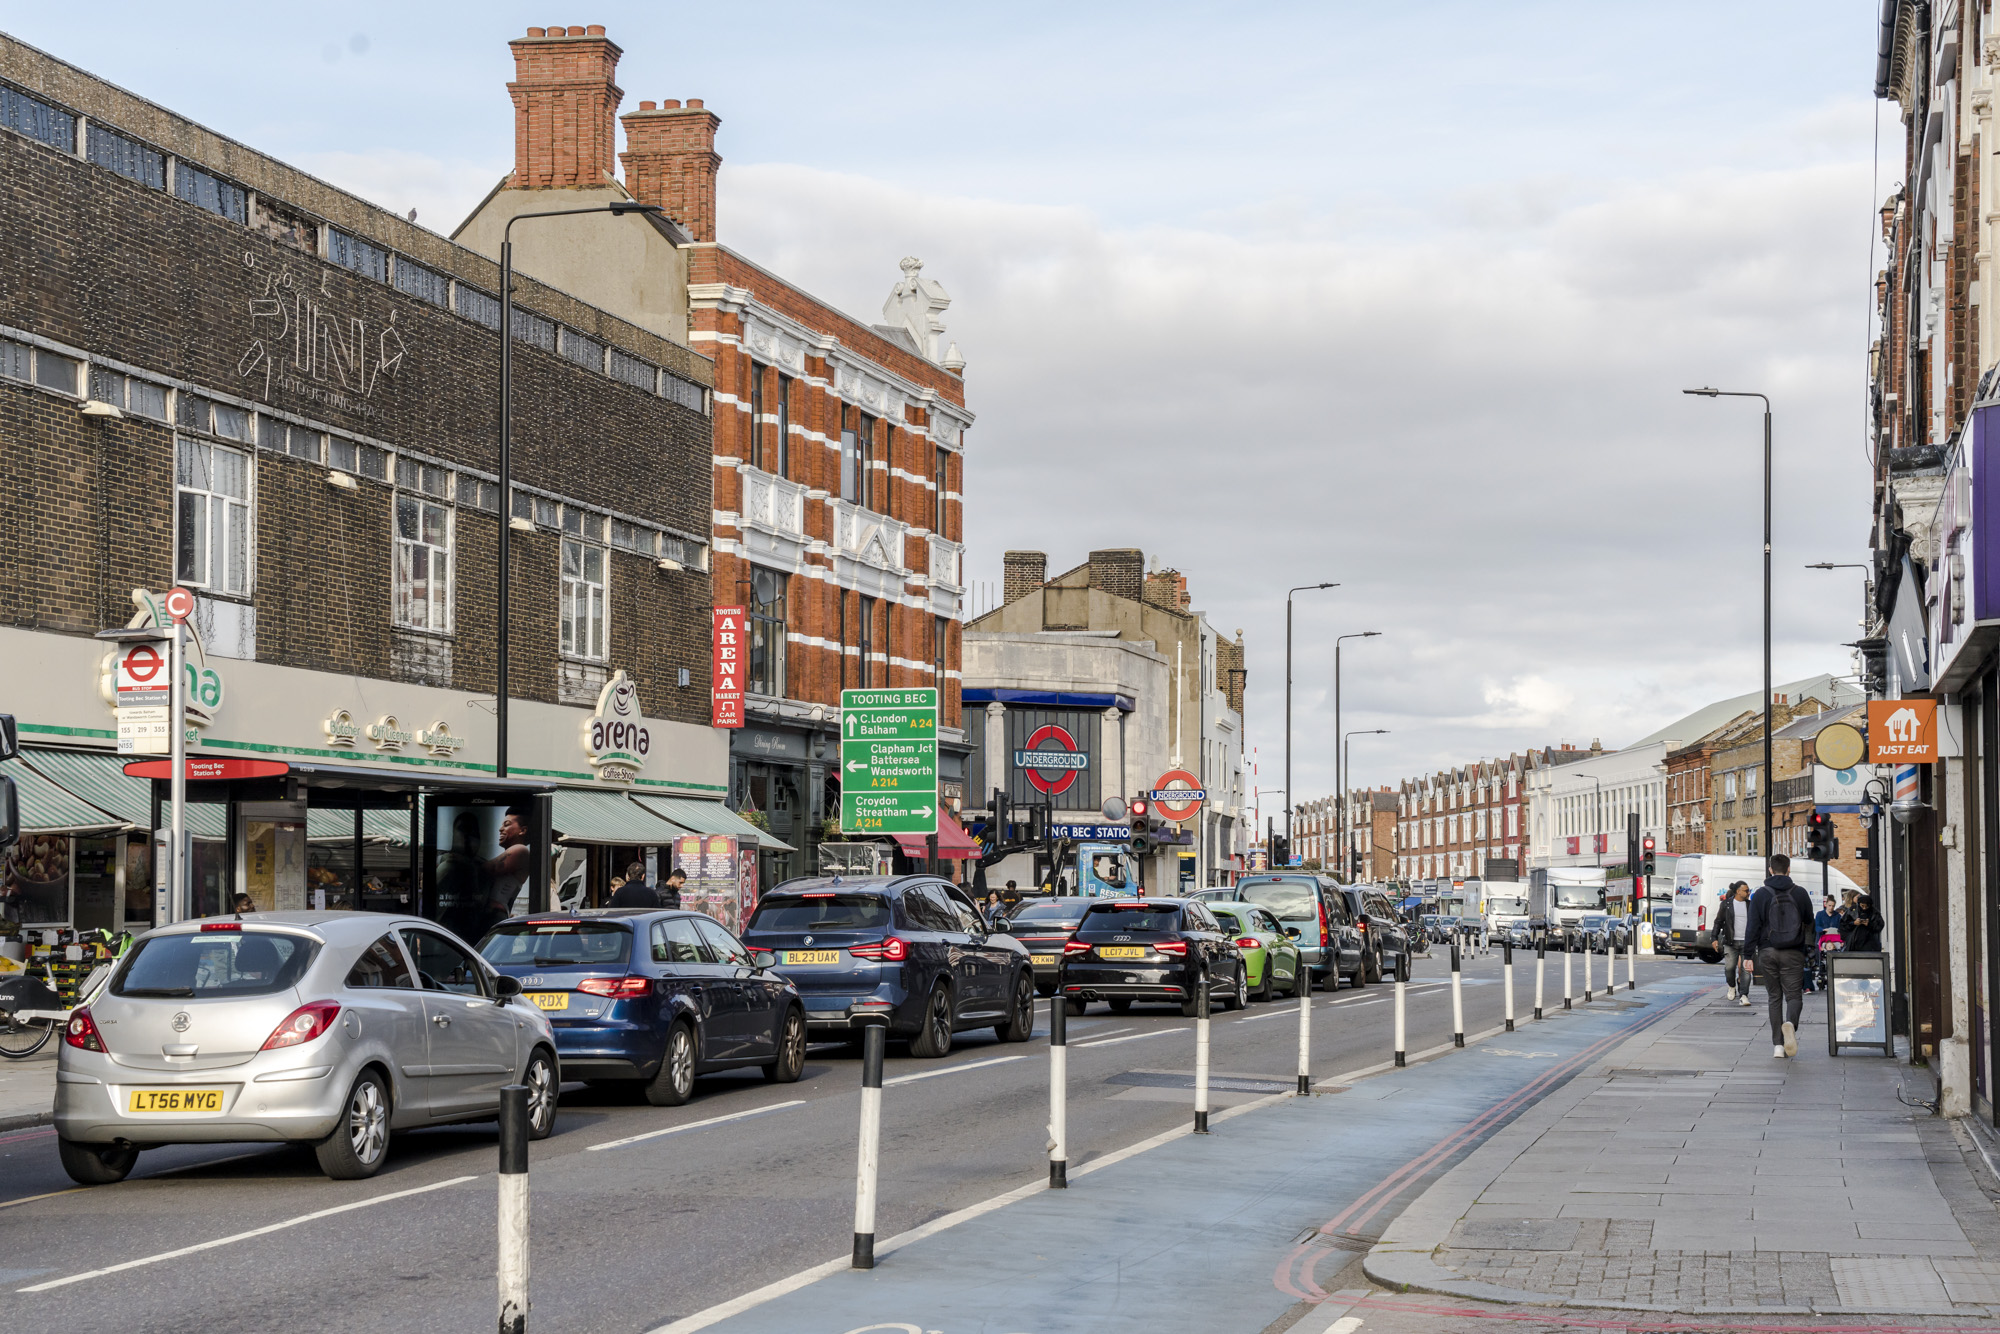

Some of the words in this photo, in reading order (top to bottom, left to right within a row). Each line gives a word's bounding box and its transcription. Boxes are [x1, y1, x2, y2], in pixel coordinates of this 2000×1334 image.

[167, 592, 186, 616] C
[719, 617, 737, 690] ARENA
[851, 694, 901, 704] TOOTING
[904, 693, 927, 703] BEC
[860, 713, 908, 724] C.London
[910, 719, 918, 728] A
[918, 718, 933, 728] 24
[329, 720, 361, 737] Butcher
[371, 725, 384, 739] Off
[384, 726, 413, 743] Licence
[860, 725, 898, 735] Balham
[421, 730, 465, 747] Delicatessen
[592, 721, 650, 756] arena
[870, 744, 915, 755] Clapham
[917, 743, 933, 753] Jct
[1877, 745, 1905, 756] JUST
[1907, 744, 1930, 755] EAT
[871, 755, 920, 765] Battersea
[1015, 751, 1087, 769] UNDERGROUND
[870, 766, 933, 776] Wandsworth
[871, 778, 879, 787] A
[880, 777, 898, 787] 214
[1150, 790, 1205, 800] UNDERGROUND
[855, 796, 898, 807] Croydon
[855, 807, 908, 817] Streatham
[855, 818, 863, 828] A
[864, 818, 882, 827] 214
[1072, 827, 1091, 837] BEC
[1097, 827, 1130, 838] STATIO
[788, 952, 815, 963] BL23
[817, 952, 838, 962] UAK
[1124, 948, 1140, 956] JVL
[538, 994, 564, 1007] RDX
[136, 1093, 180, 1109] LT56
[184, 1092, 216, 1108] MYG
